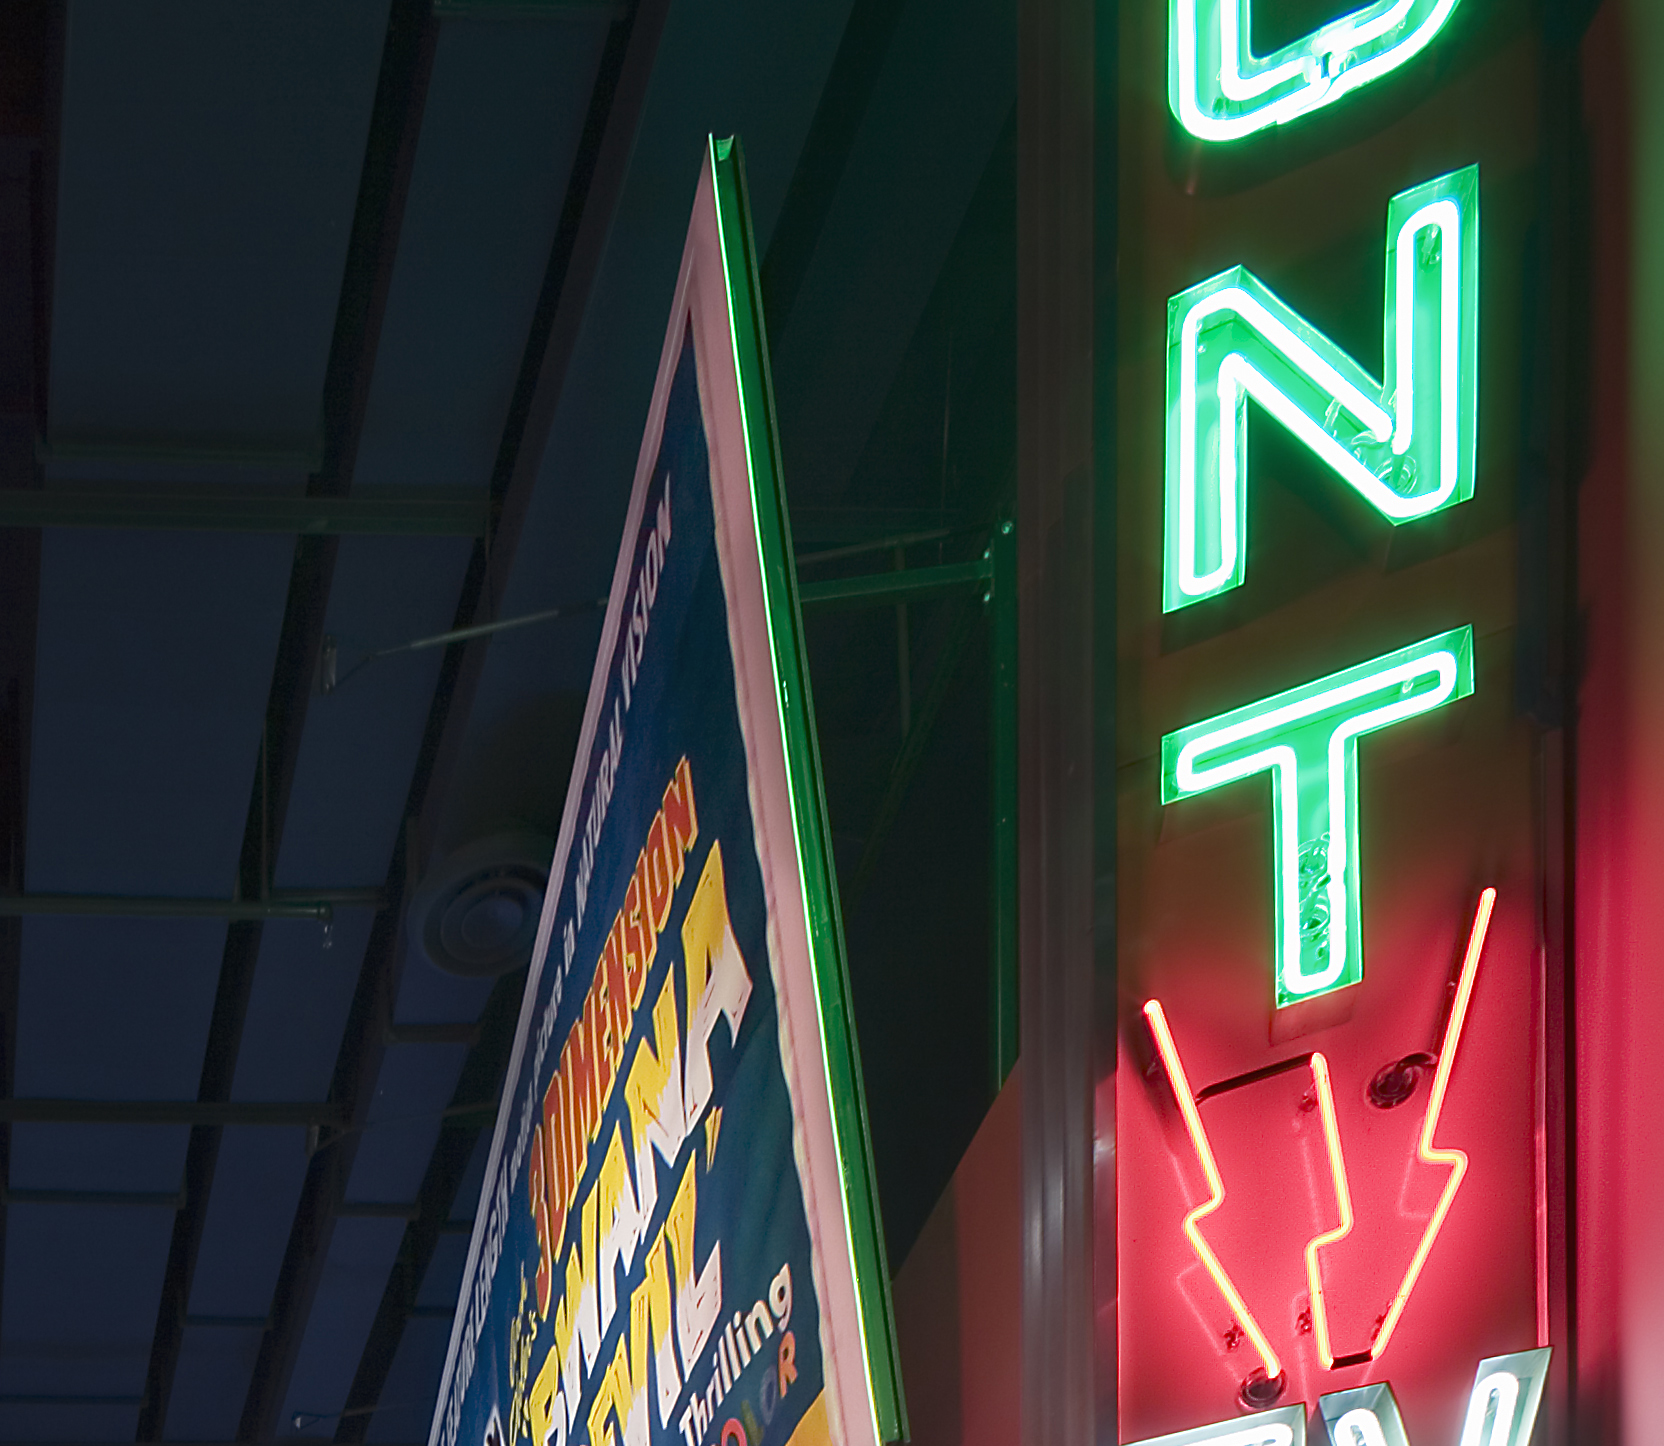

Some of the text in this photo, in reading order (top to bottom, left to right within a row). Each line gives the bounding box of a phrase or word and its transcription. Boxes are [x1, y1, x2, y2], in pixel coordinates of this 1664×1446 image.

[474, 1156, 510, 1344] LENGTH
[563, 916, 576, 977] in
[574, 697, 625, 918] NATURAL
[621, 473, 673, 713] VISION
